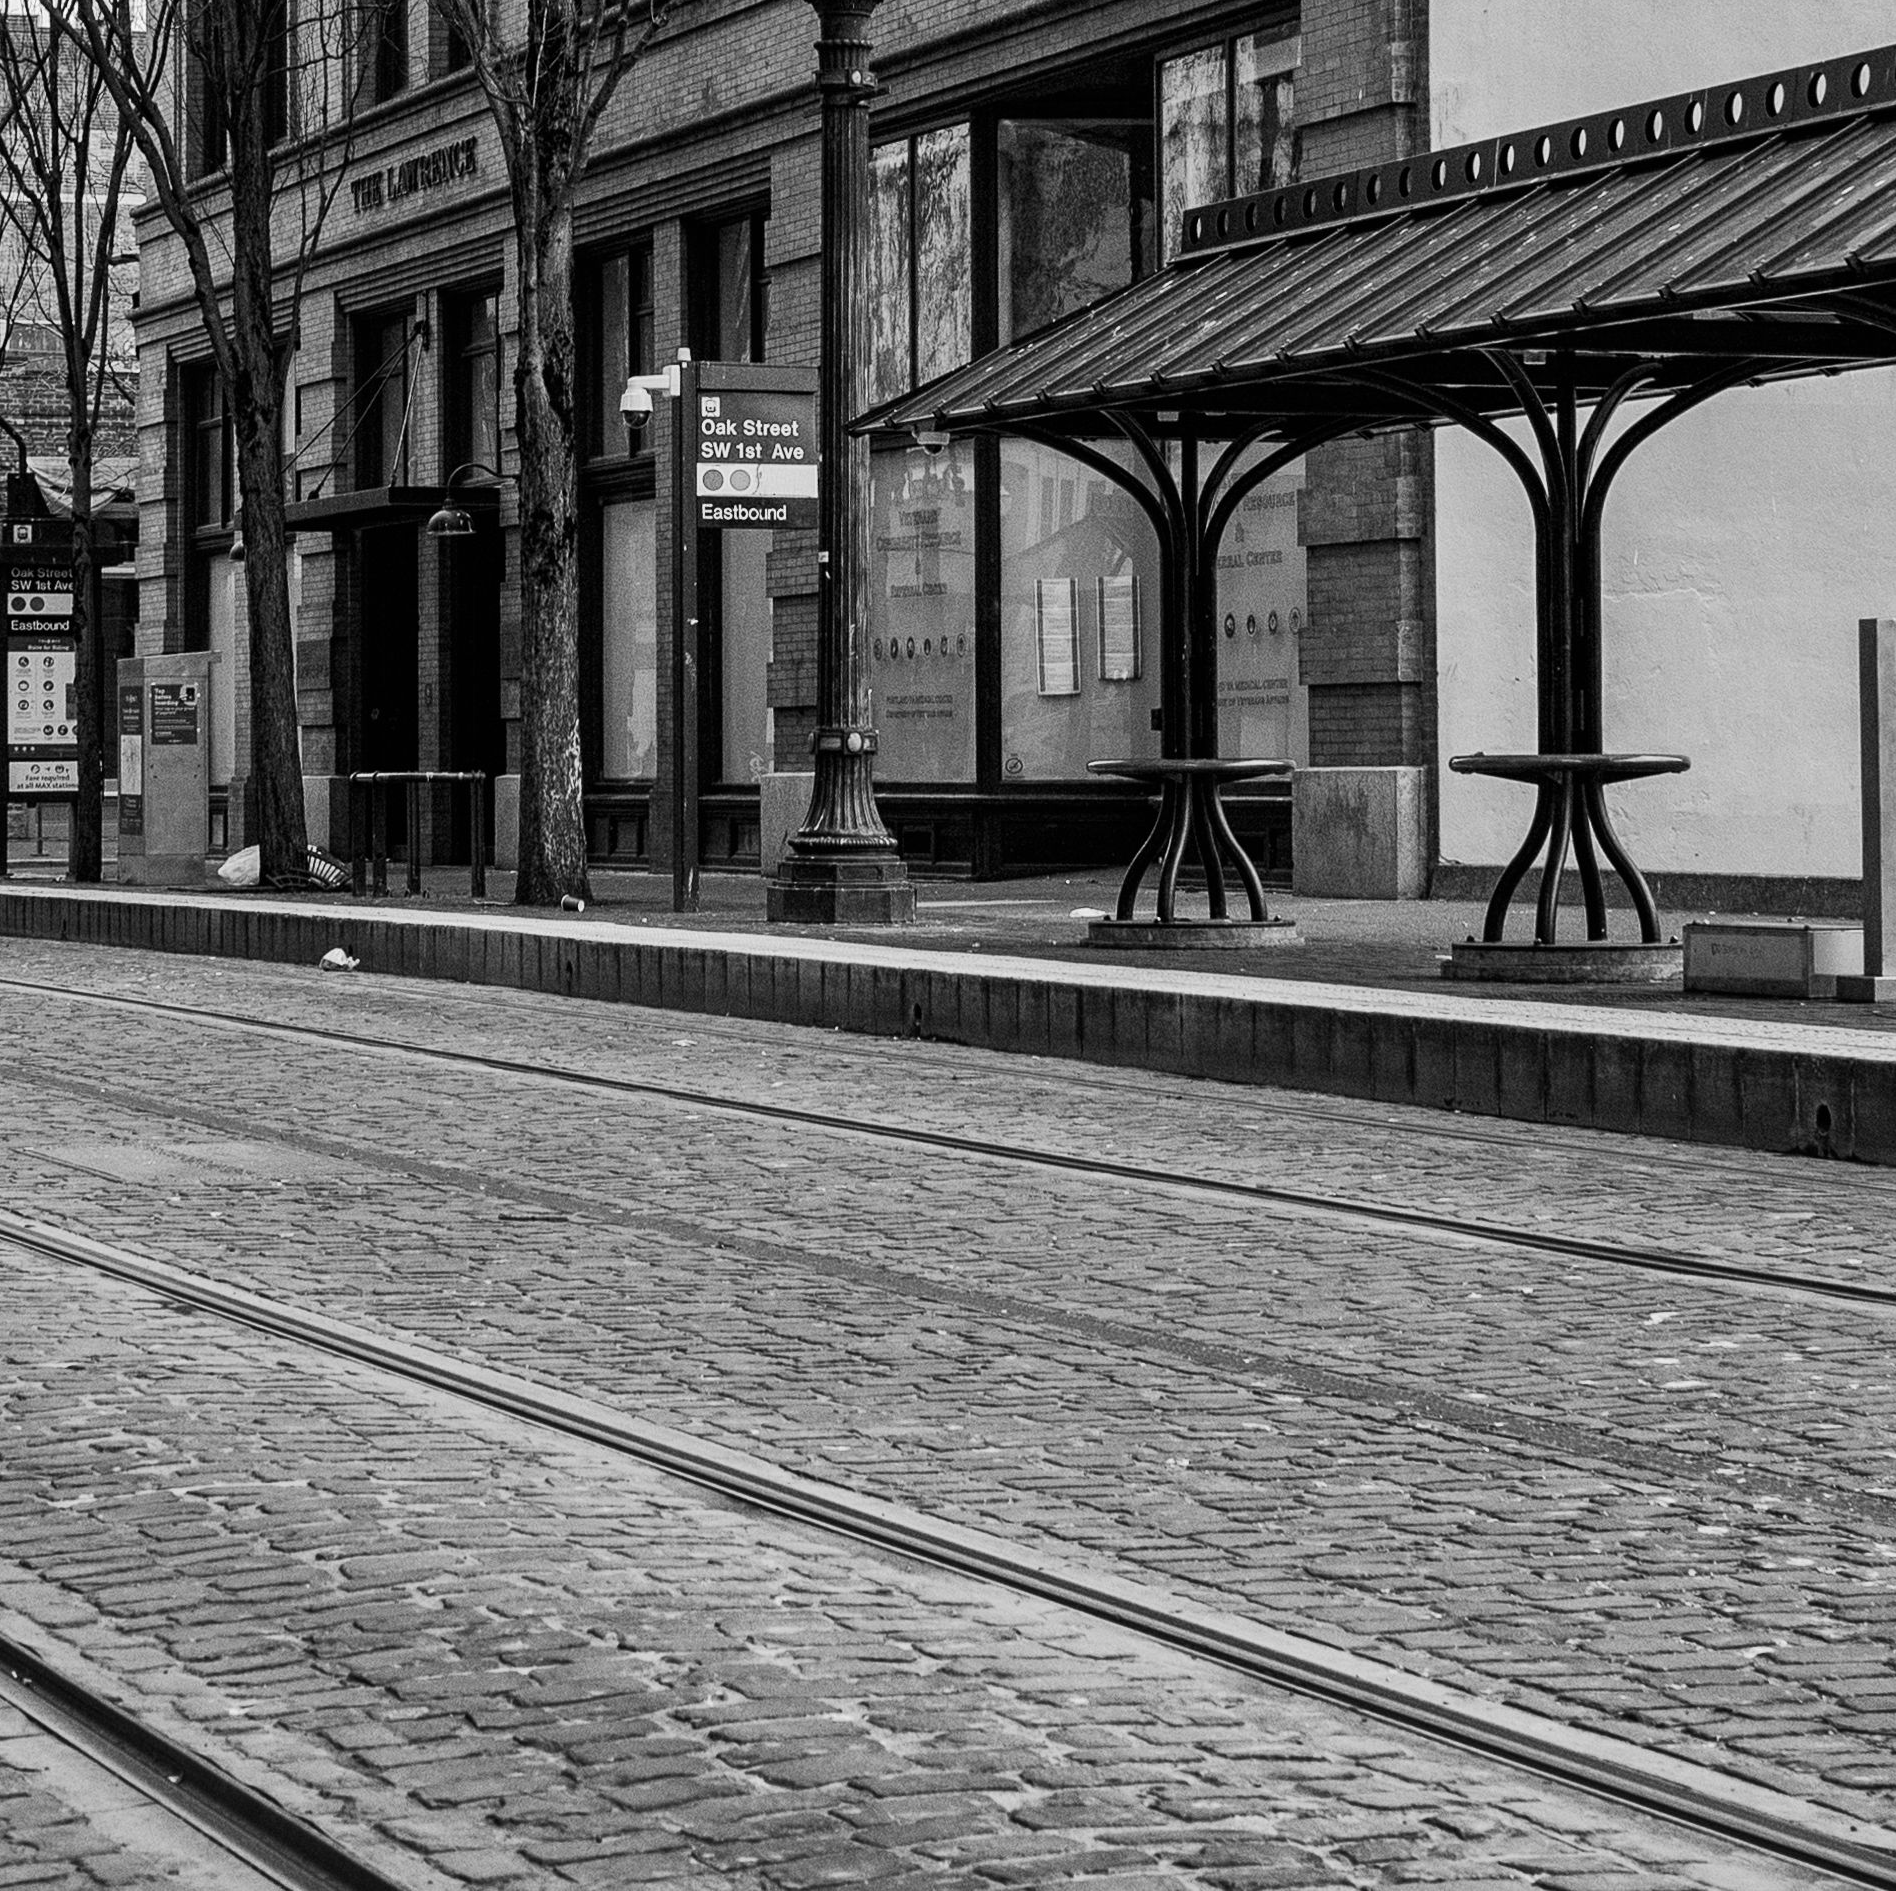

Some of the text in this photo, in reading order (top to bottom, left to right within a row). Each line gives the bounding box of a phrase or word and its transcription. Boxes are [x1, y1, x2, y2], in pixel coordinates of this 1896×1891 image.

[351, 136, 478, 213] THE LAWRENCE
[701, 419, 799, 437] Oak Street
[701, 443, 805, 459] SW 1st Ave
[701, 504, 787, 521] Eastbound
[11, 568, 73, 578] Oak Street
[11, 580, 32, 591] SW
[35, 580, 52, 591] 1st
[11, 620, 70, 631] Eastbound
[41, 774, 70, 784] required
